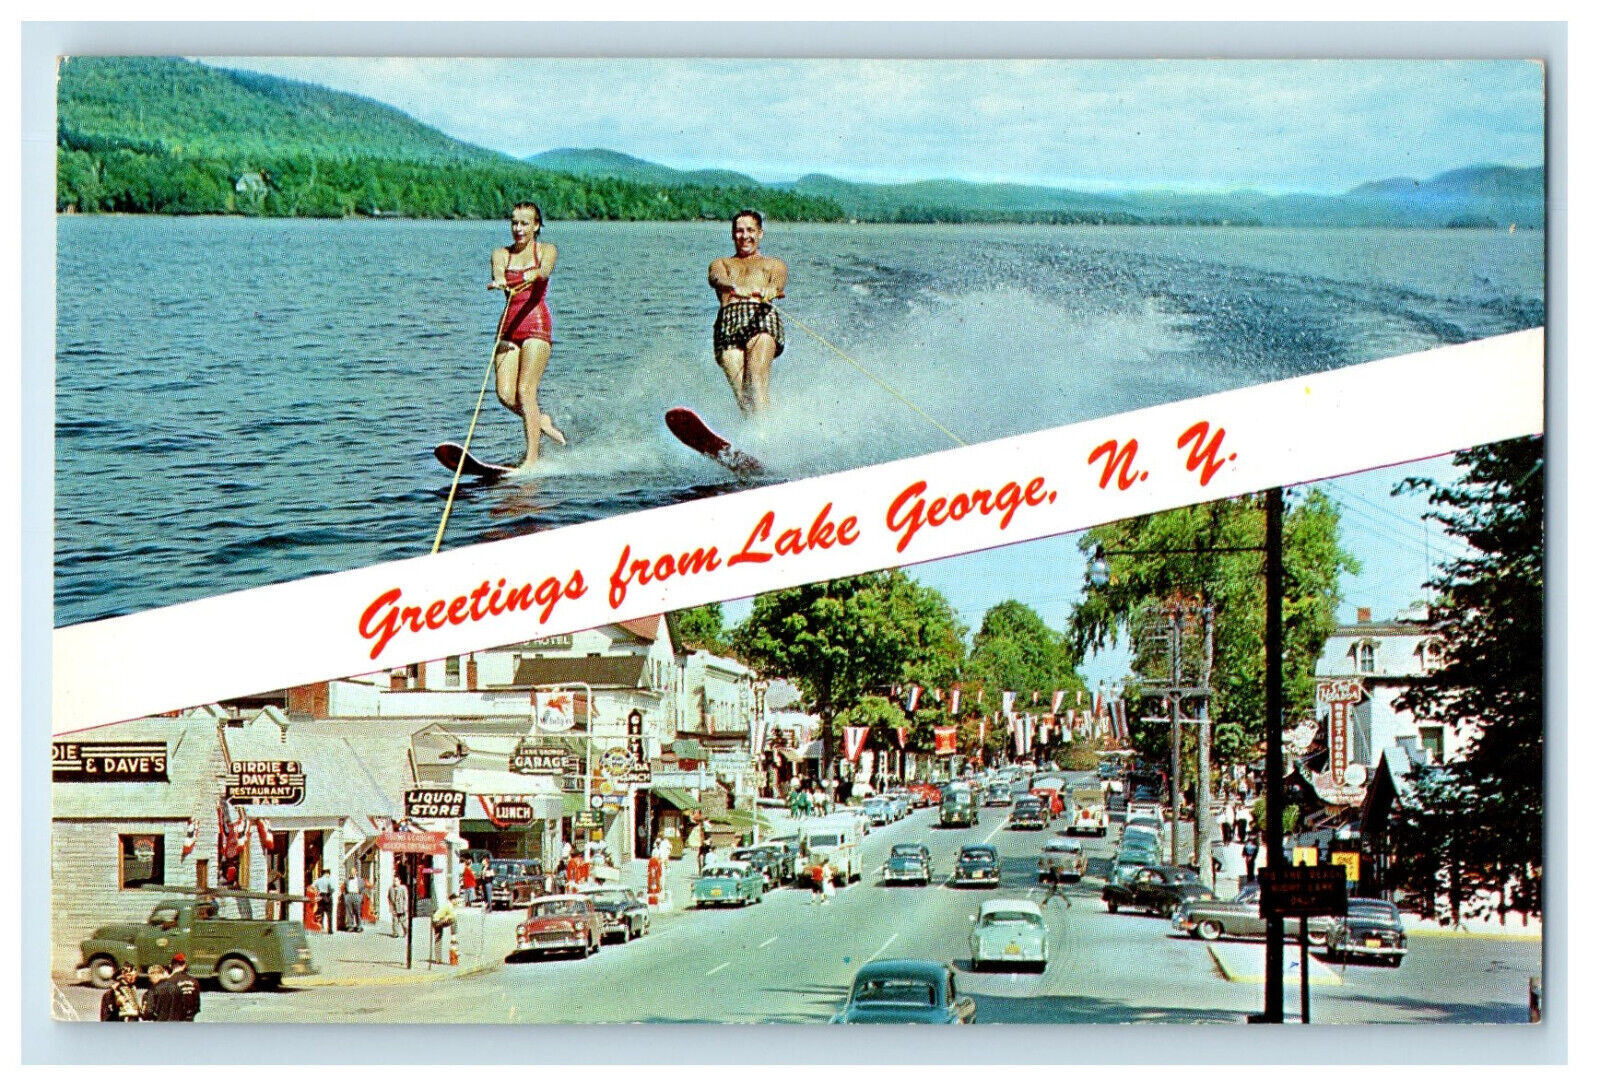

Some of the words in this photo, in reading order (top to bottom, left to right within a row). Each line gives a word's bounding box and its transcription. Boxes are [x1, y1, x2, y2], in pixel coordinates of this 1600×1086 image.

[358, 568, 588, 660] Greetings
[610, 544, 722, 609] from
[728, 502, 860, 568] Lake
[1087, 438, 1149, 491] N.
[1177, 420, 1238, 487] Y.
[86, 758, 97, 773] &
[104, 755, 165, 773] DAVE'S
[232, 761, 281, 773] BIRDIE
[287, 761, 296, 773] &
[515, 756, 569, 768] GARAGE
[241, 773, 289, 786] DAVE'S
[229, 786, 291, 796] RESTAURANT
[252, 796, 280, 805] BAR
[408, 792, 464, 804] LIQUOR
[410, 804, 461, 816] STORE
[495, 806, 532, 819] LUNCH
